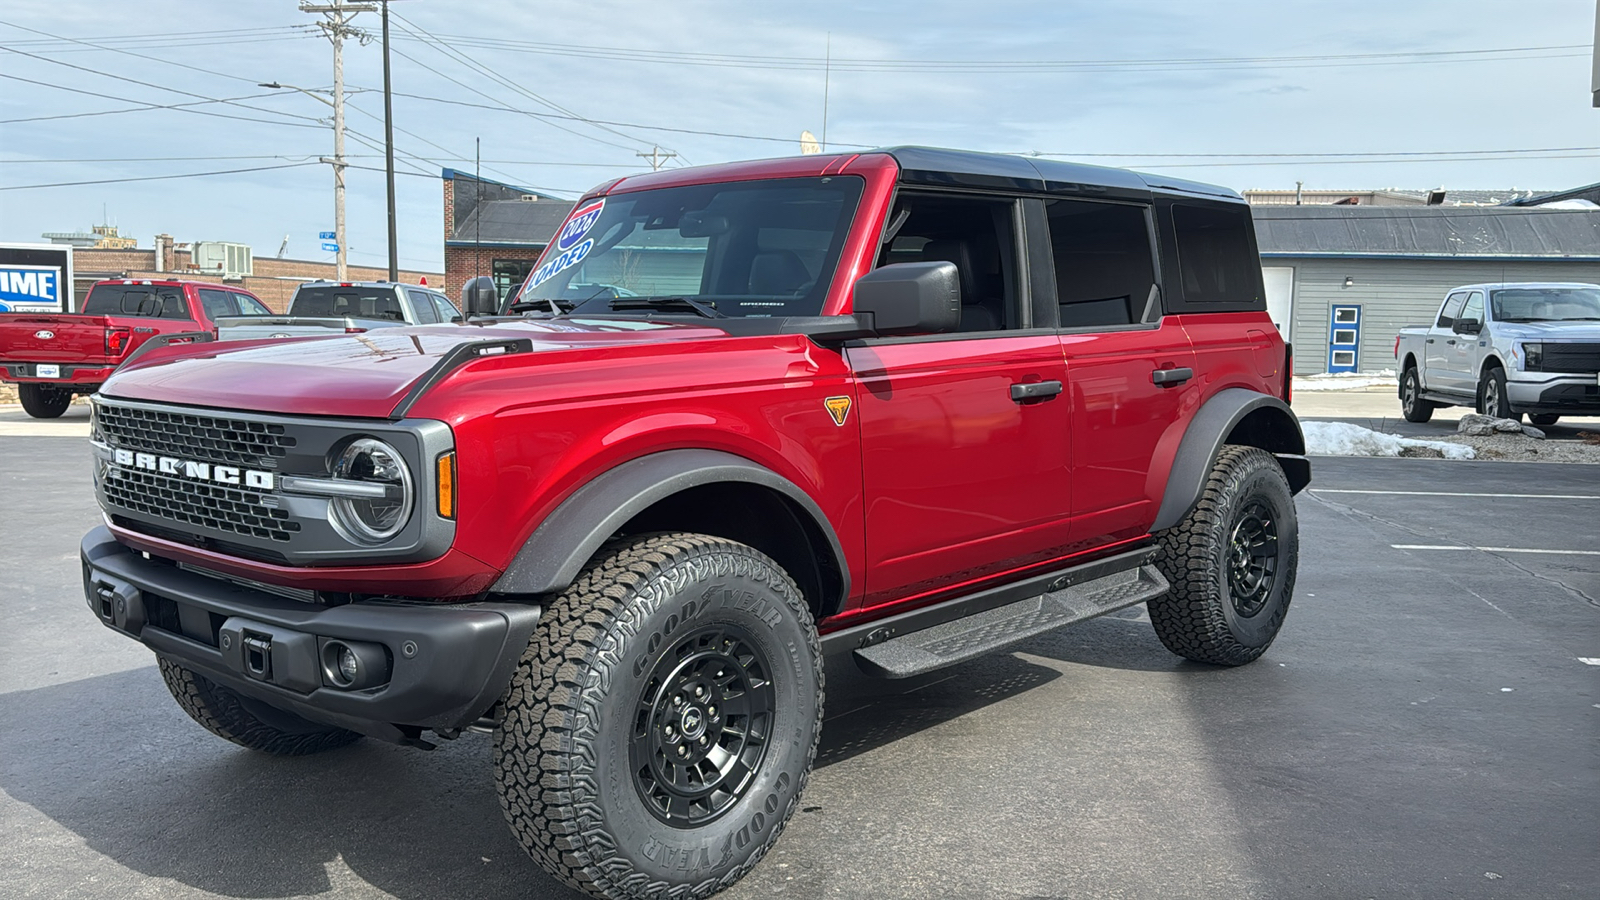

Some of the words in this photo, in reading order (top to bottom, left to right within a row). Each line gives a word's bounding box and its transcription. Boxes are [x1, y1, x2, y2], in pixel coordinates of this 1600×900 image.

[562, 211, 595, 240] 2026
[527, 241, 591, 291] LOADED
[115, 450, 273, 489] BRONCO
